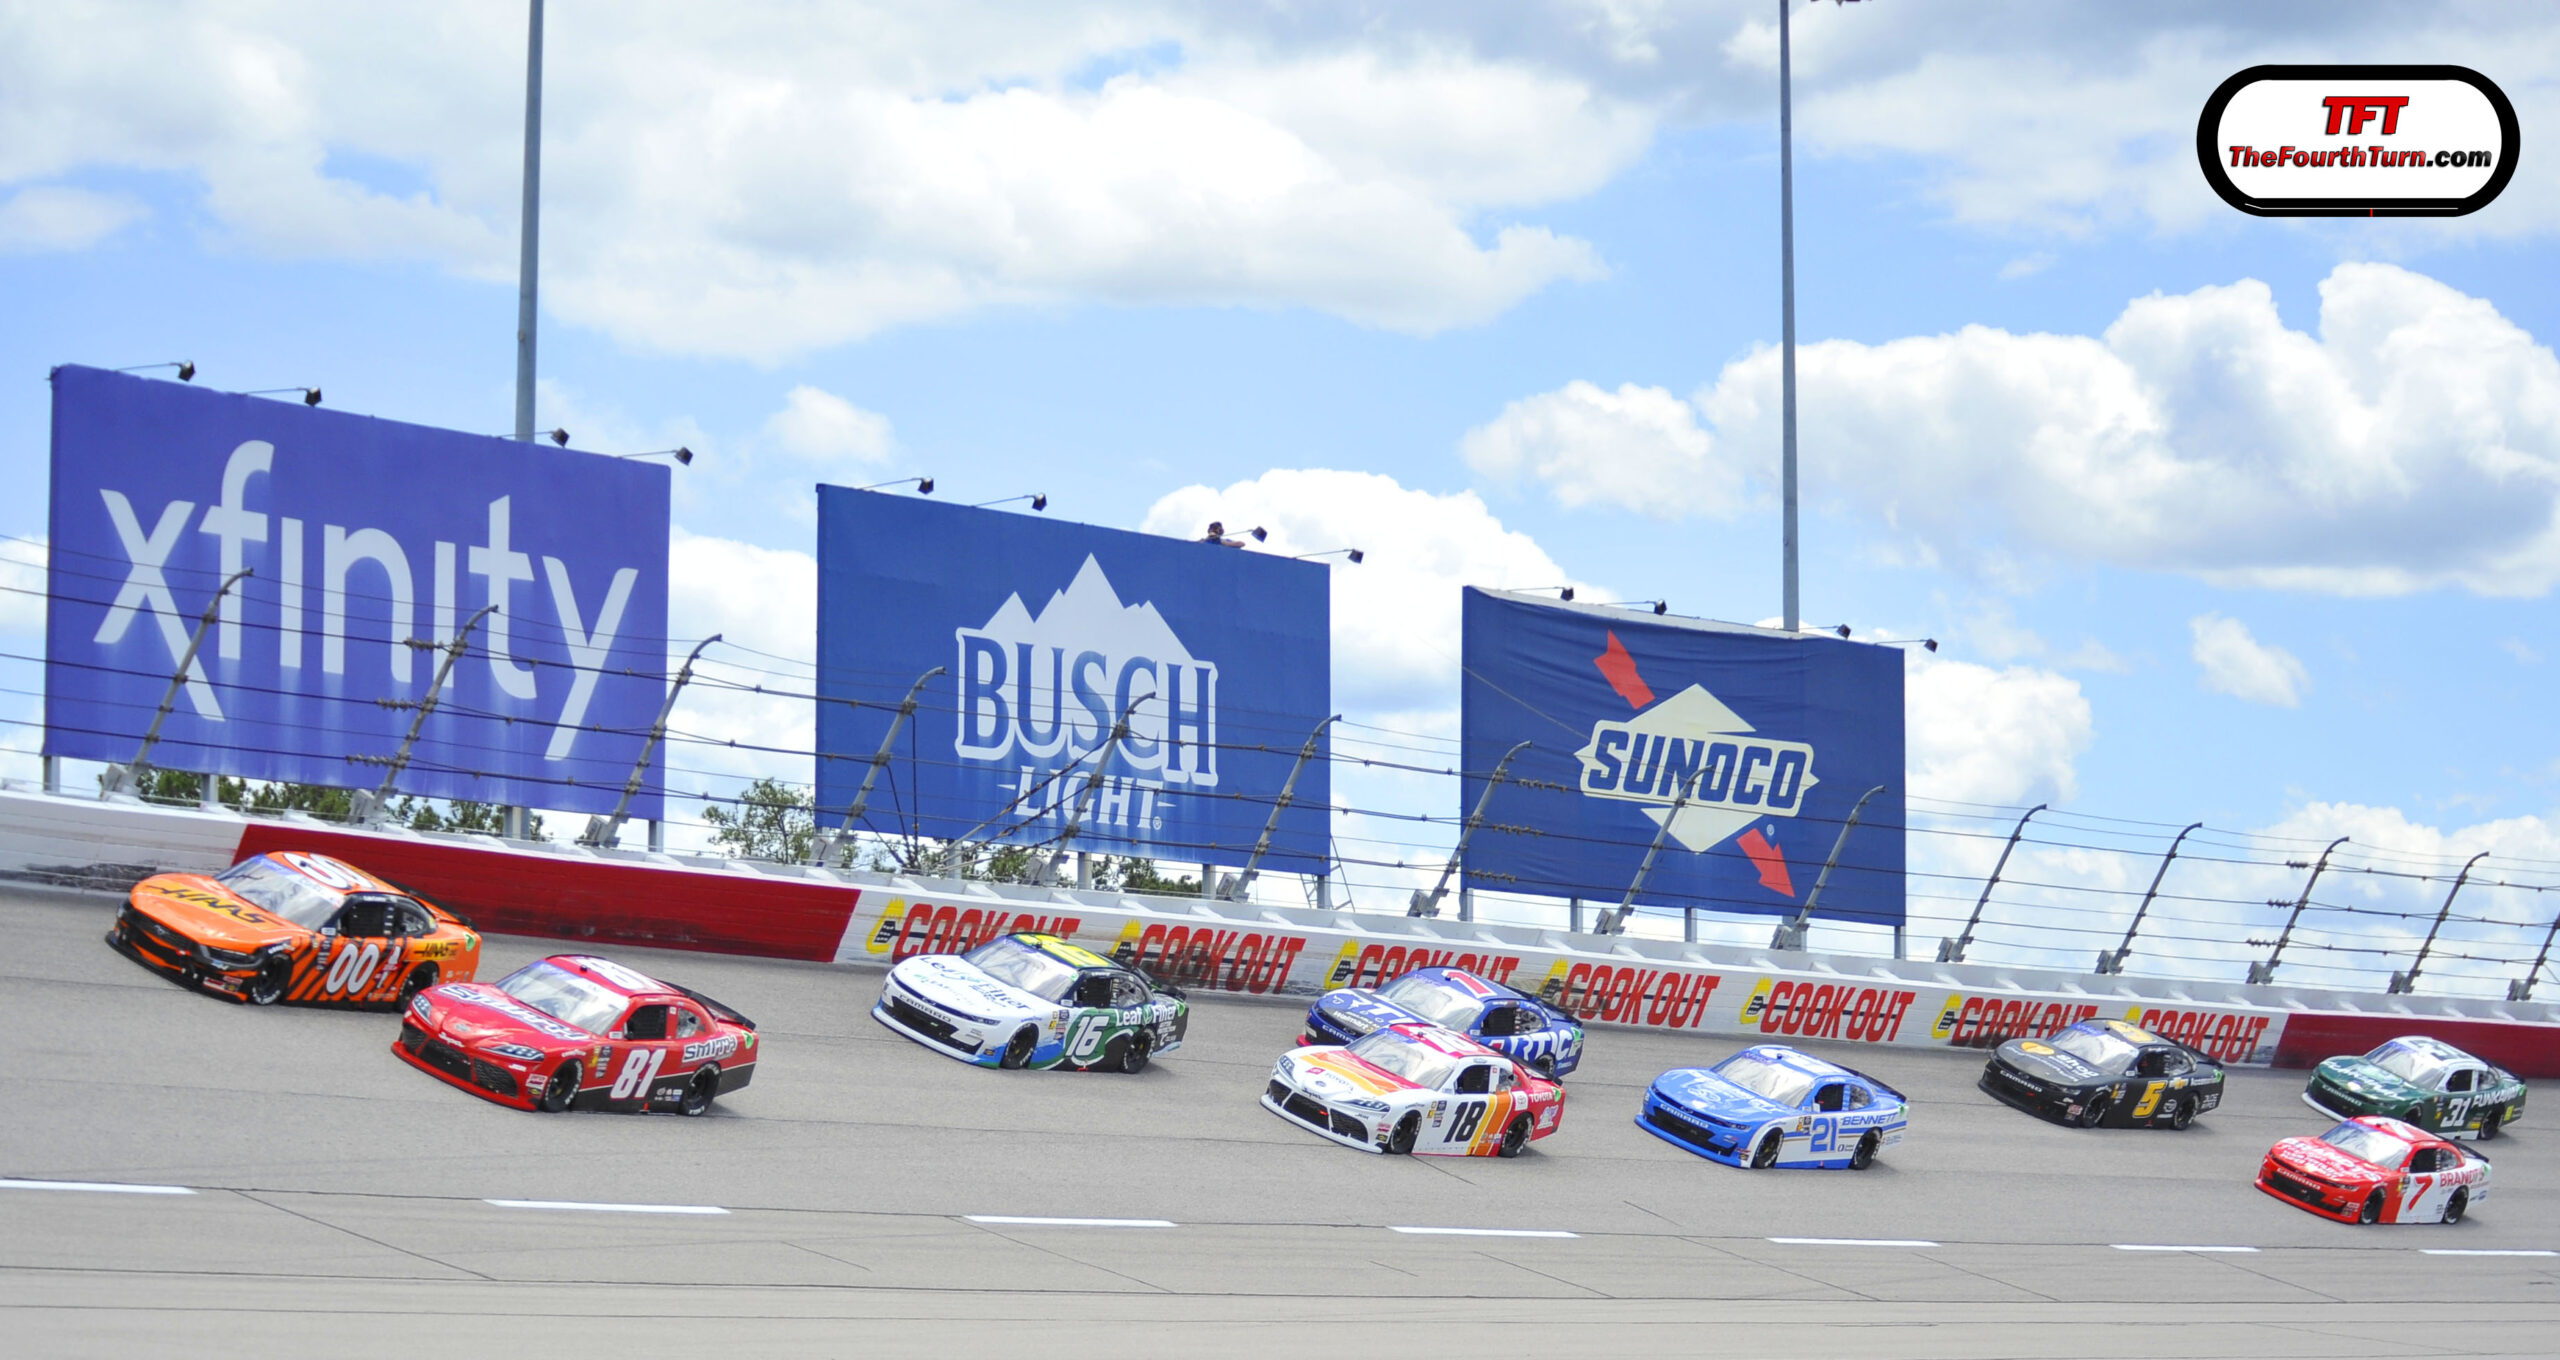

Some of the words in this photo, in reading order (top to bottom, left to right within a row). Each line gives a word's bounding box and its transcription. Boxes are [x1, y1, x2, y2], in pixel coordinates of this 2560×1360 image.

[93, 440, 639, 761] xfinity
[958, 632, 1214, 776] BUSCH
[1588, 728, 1807, 810] SUNOCO
[1014, 765, 1164, 829] LIGHT
[892, 902, 1009, 964] COOK
[326, 942, 380, 995] 00
[1133, 924, 1239, 990] COOK
[1227, 933, 1306, 995] OUT
[899, 994, 952, 1023] CAMARO
[1115, 1006, 1143, 1027] Leaf
[1151, 1004, 1177, 1024] Filter
[1561, 962, 1658, 1025] COOK
[1647, 972, 1721, 1029] OUT
[1760, 980, 1856, 1039] COOK
[1846, 988, 1917, 1043] OUT
[1065, 1015, 1110, 1056] 16
[1952, 996, 2043, 1049] COOK
[2208, 1014, 2270, 1064] OUT
[682, 1035, 738, 1063] SMITH
[610, 1049, 667, 1099] 81
[1999, 1069, 2043, 1093] CAMARO
[1529, 1091, 1554, 1103] TOYOTA
[1660, 1103, 1709, 1129] CAMARO
[1842, 1111, 1899, 1126] BENNETT
[2132, 1080, 2168, 1119] 5
[2440, 1098, 2472, 1128] 31
[1443, 1100, 1487, 1143] 18
[1810, 1116, 1838, 1152] 21
[2408, 1174, 2433, 1211] 7
